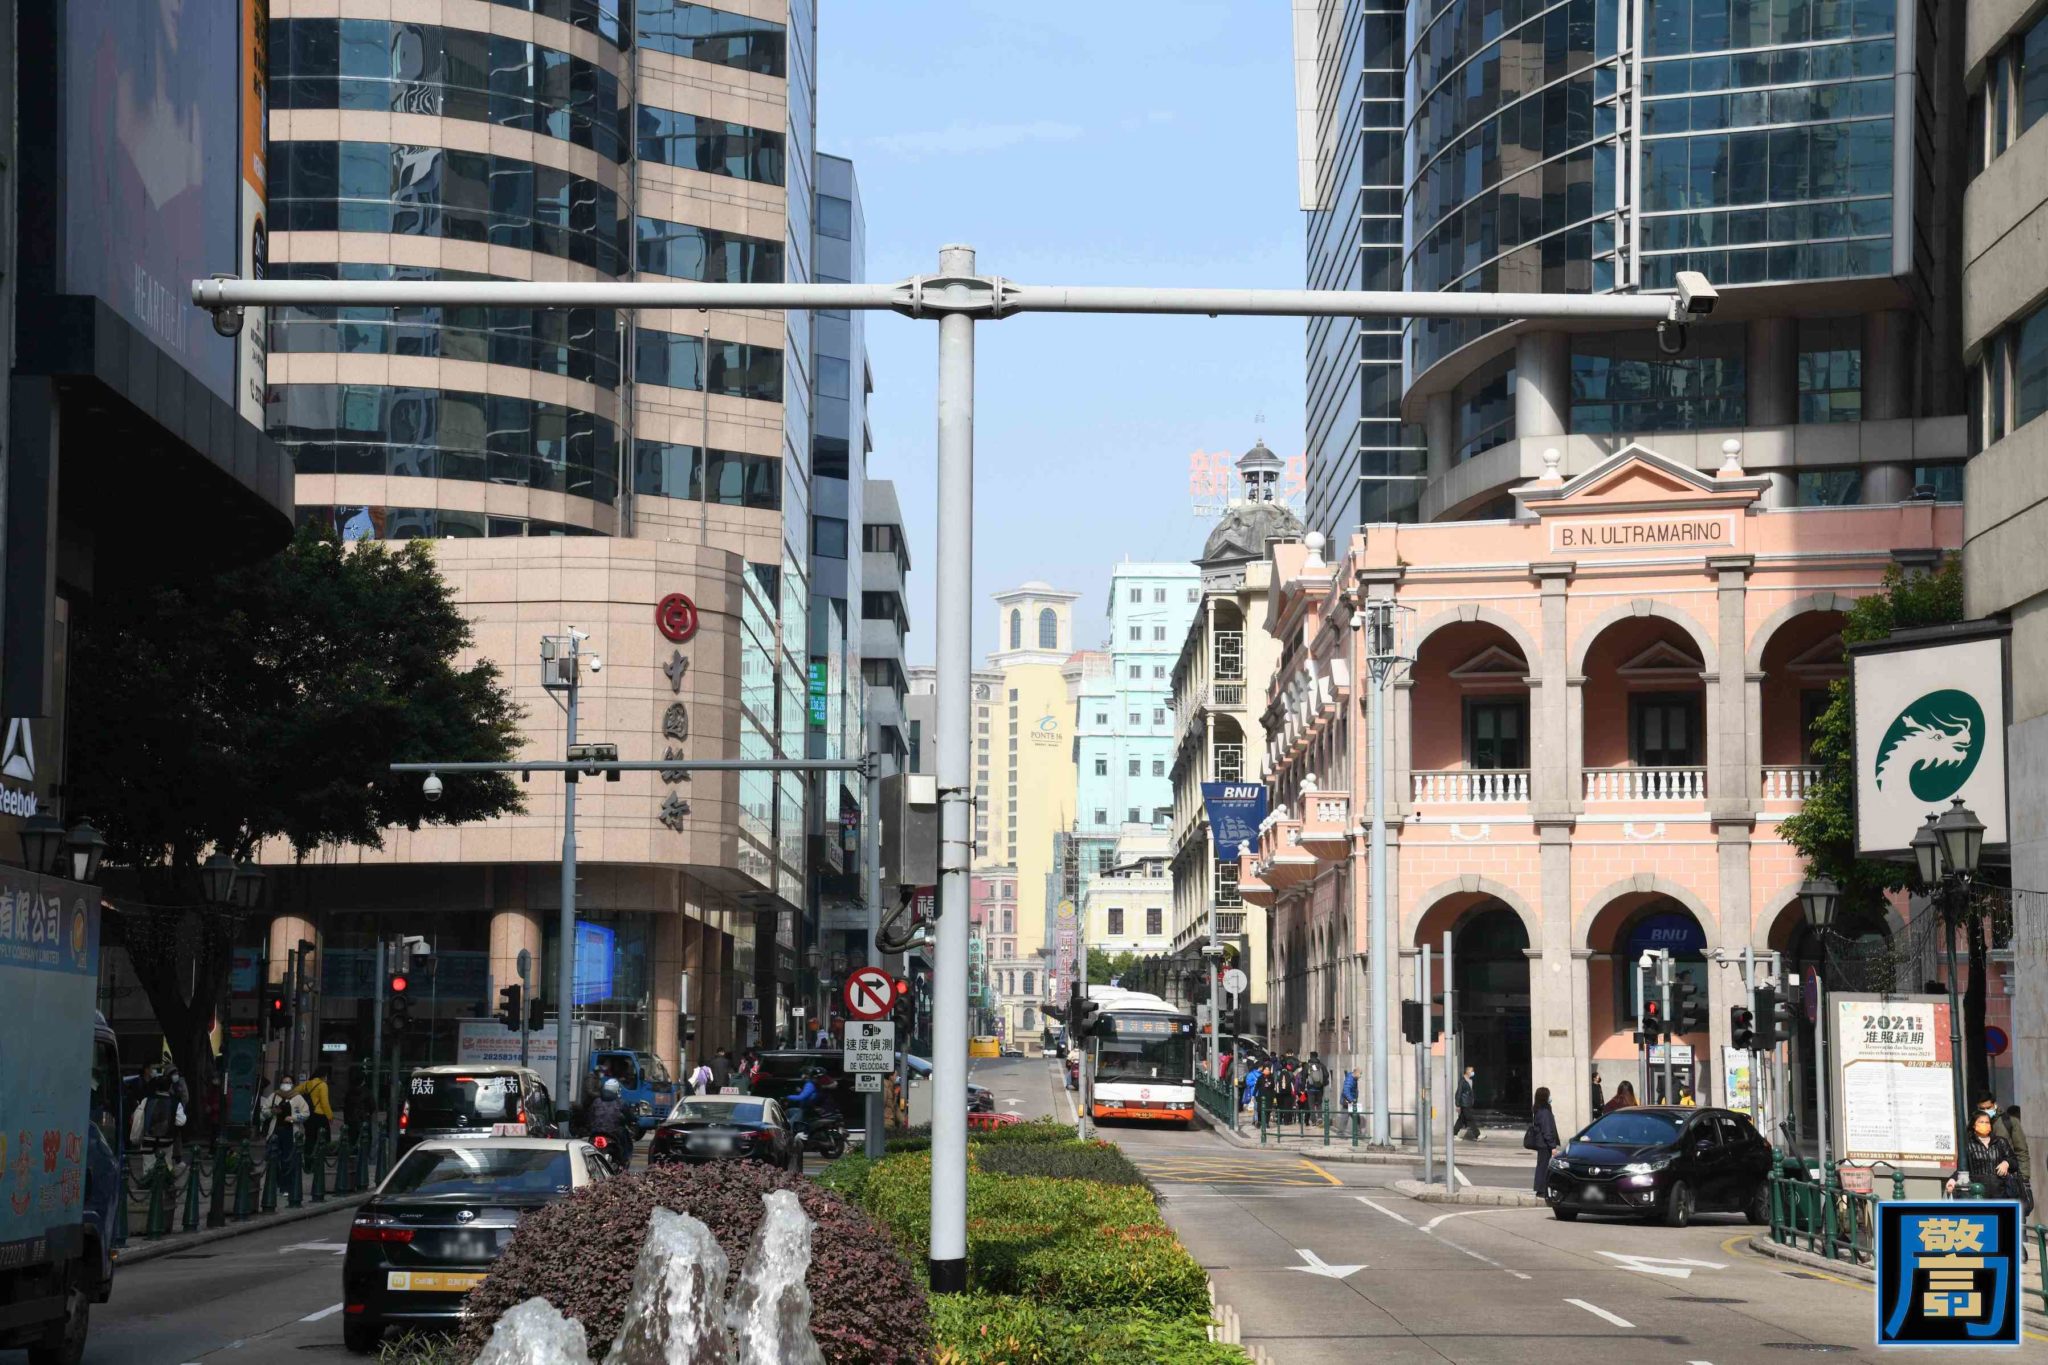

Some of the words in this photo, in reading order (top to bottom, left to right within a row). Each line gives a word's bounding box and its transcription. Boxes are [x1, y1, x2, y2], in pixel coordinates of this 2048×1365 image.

[134, 263, 188, 353] HEARTBEAT
[1562, 528, 1577, 546] B.
[1581, 527, 1597, 545] N.
[1601, 522, 1721, 544] ULTRAMARINO
[1224, 787, 1259, 798] BNU
[0, 783, 38, 818] Reebok
[1652, 929, 1688, 942] BNU
[1863, 1015, 1914, 1030] 2021
[1863, 1031, 1925, 1044] 准照續期
[846, 1037, 893, 1051] 速度偵測
[859, 1062, 889, 1070] VELOCIDADE
[411, 1078, 435, 1087] 的士
[494, 1077, 517, 1086] 的士
[412, 1087, 434, 1095] TAXI
[495, 1086, 518, 1094] TAXI
[495, 1125, 525, 1135] TAXI
